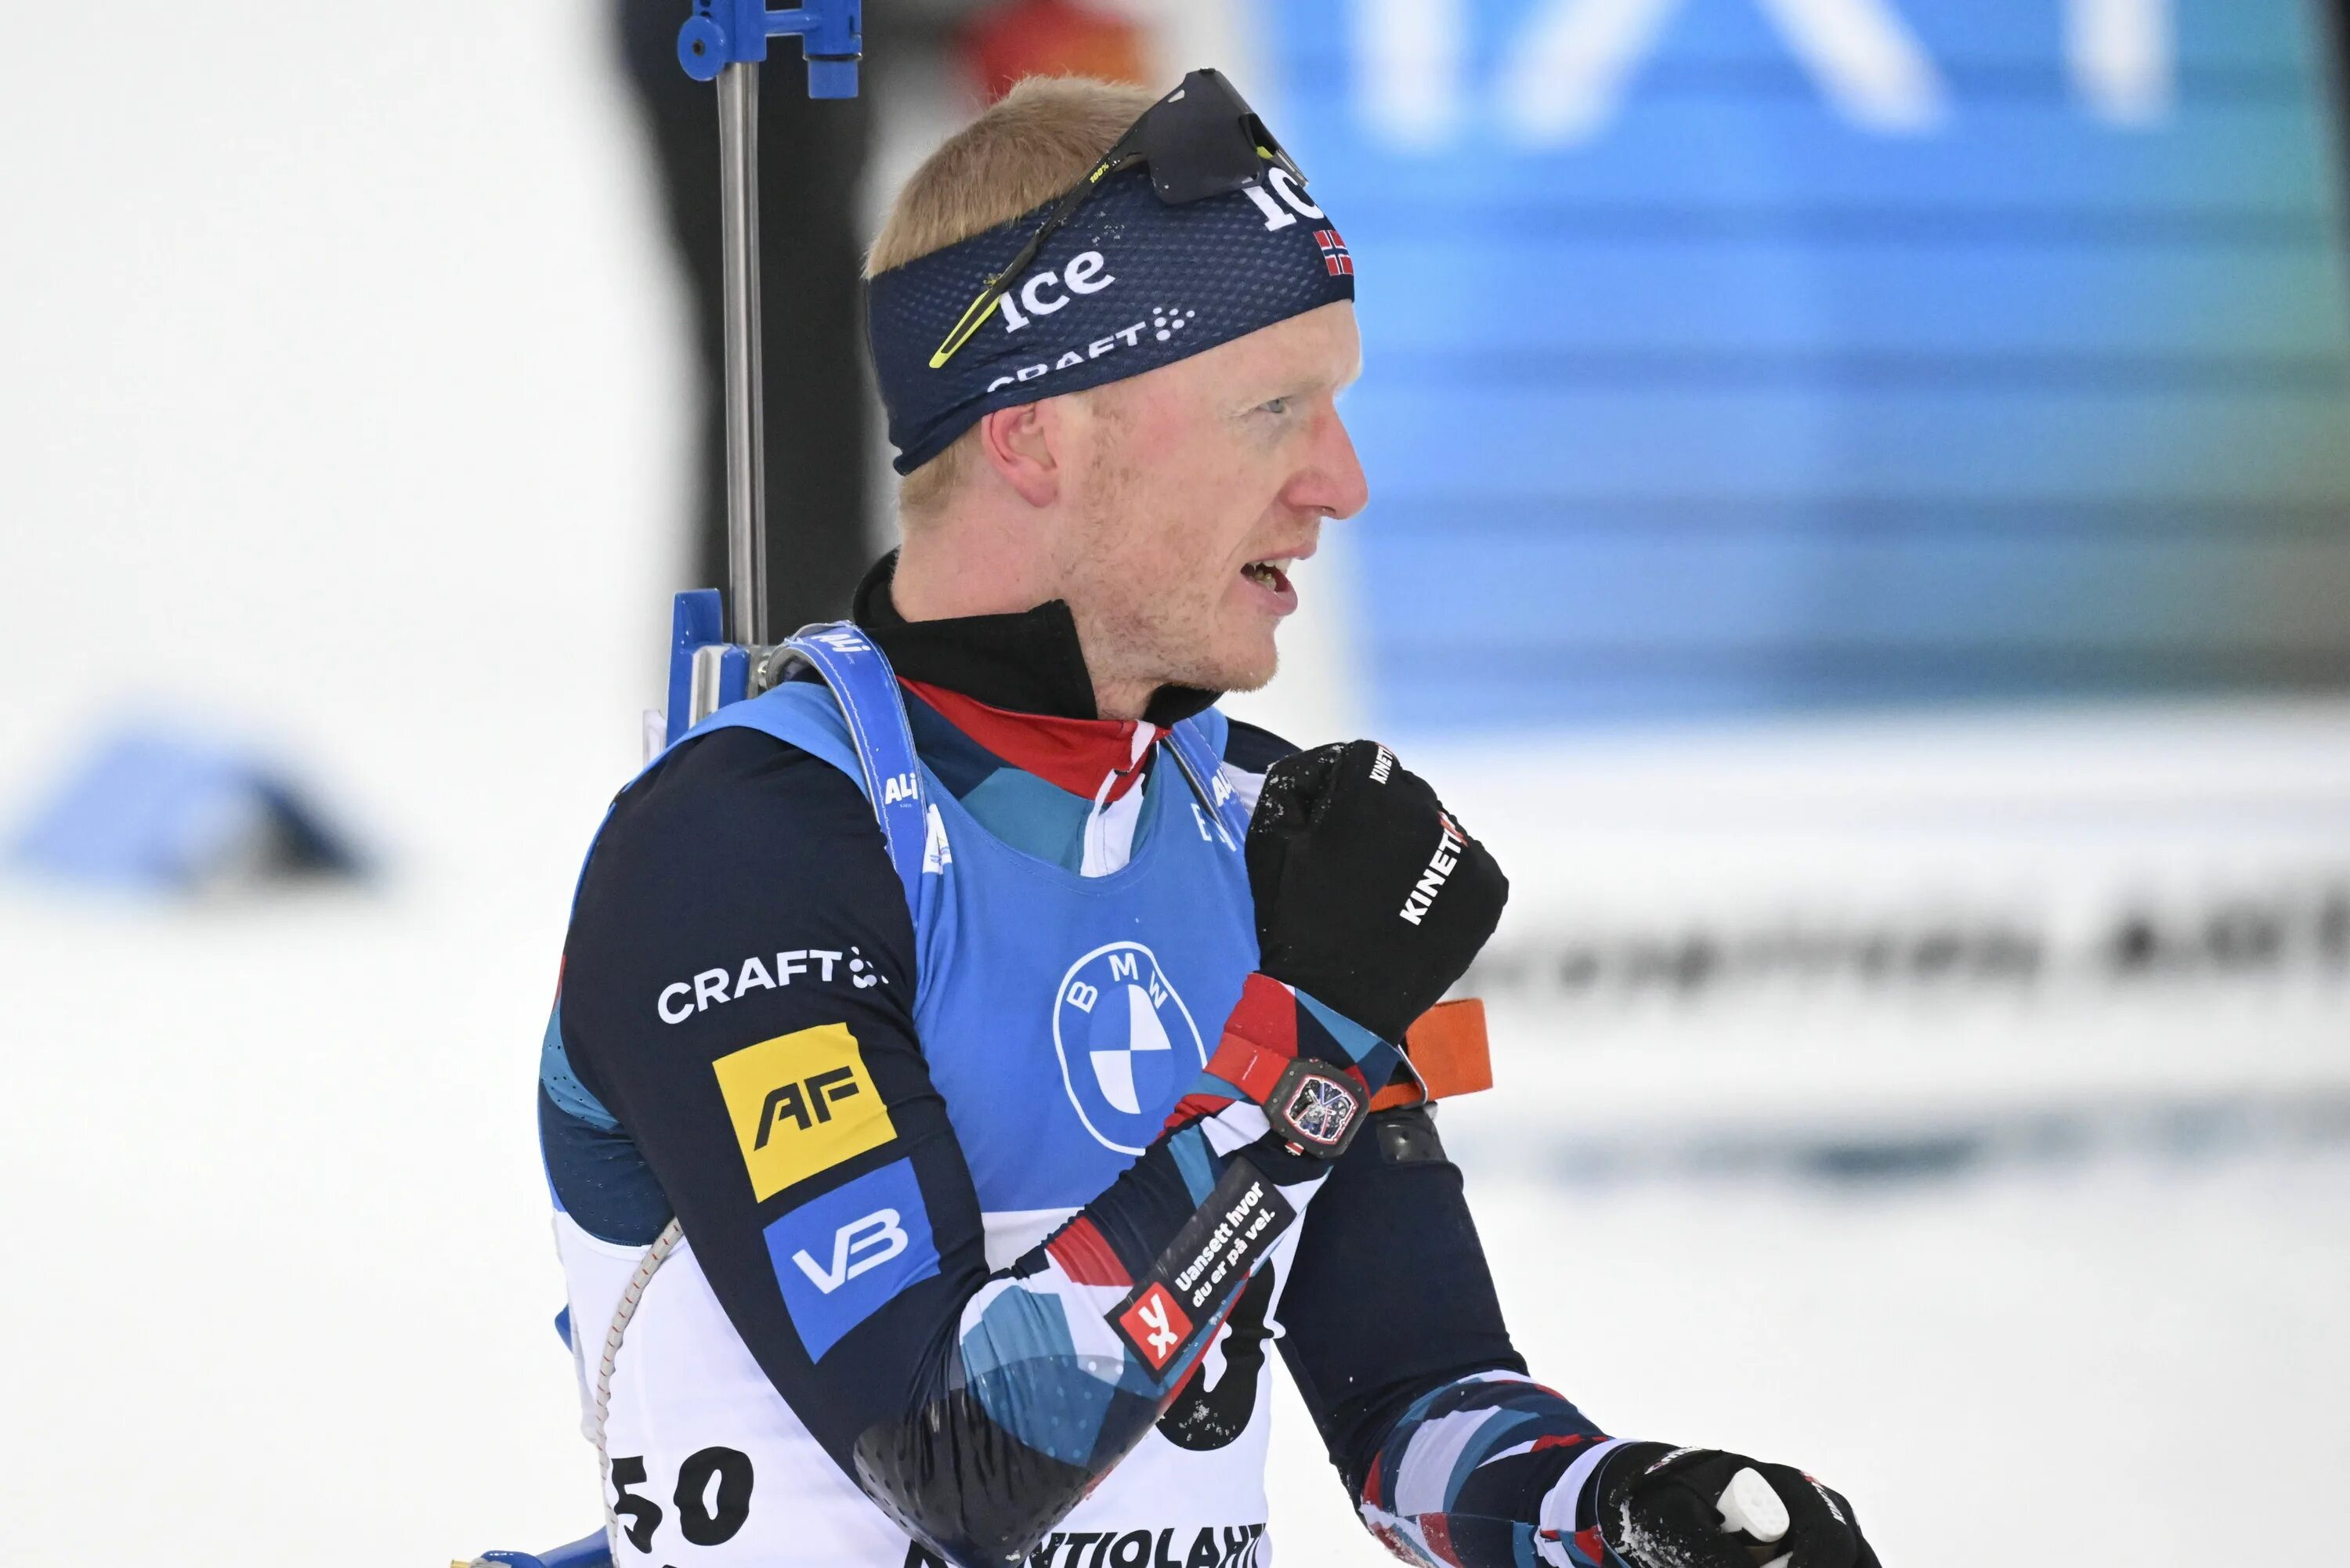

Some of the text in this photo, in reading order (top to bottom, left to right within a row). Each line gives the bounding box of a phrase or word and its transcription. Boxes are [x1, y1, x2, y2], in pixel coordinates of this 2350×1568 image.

[1090, 161, 1109, 183] 100%
[658, 949, 842, 1024] CRAFT
[1066, 952, 1169, 1014] BMW
[754, 1066, 859, 1151] AF
[792, 1208, 909, 1295] VB
[1175, 1181, 1264, 1292] Uansett hvor
[1192, 1208, 1276, 1308] du er på vei.
[610, 1446, 754, 1555] 50
